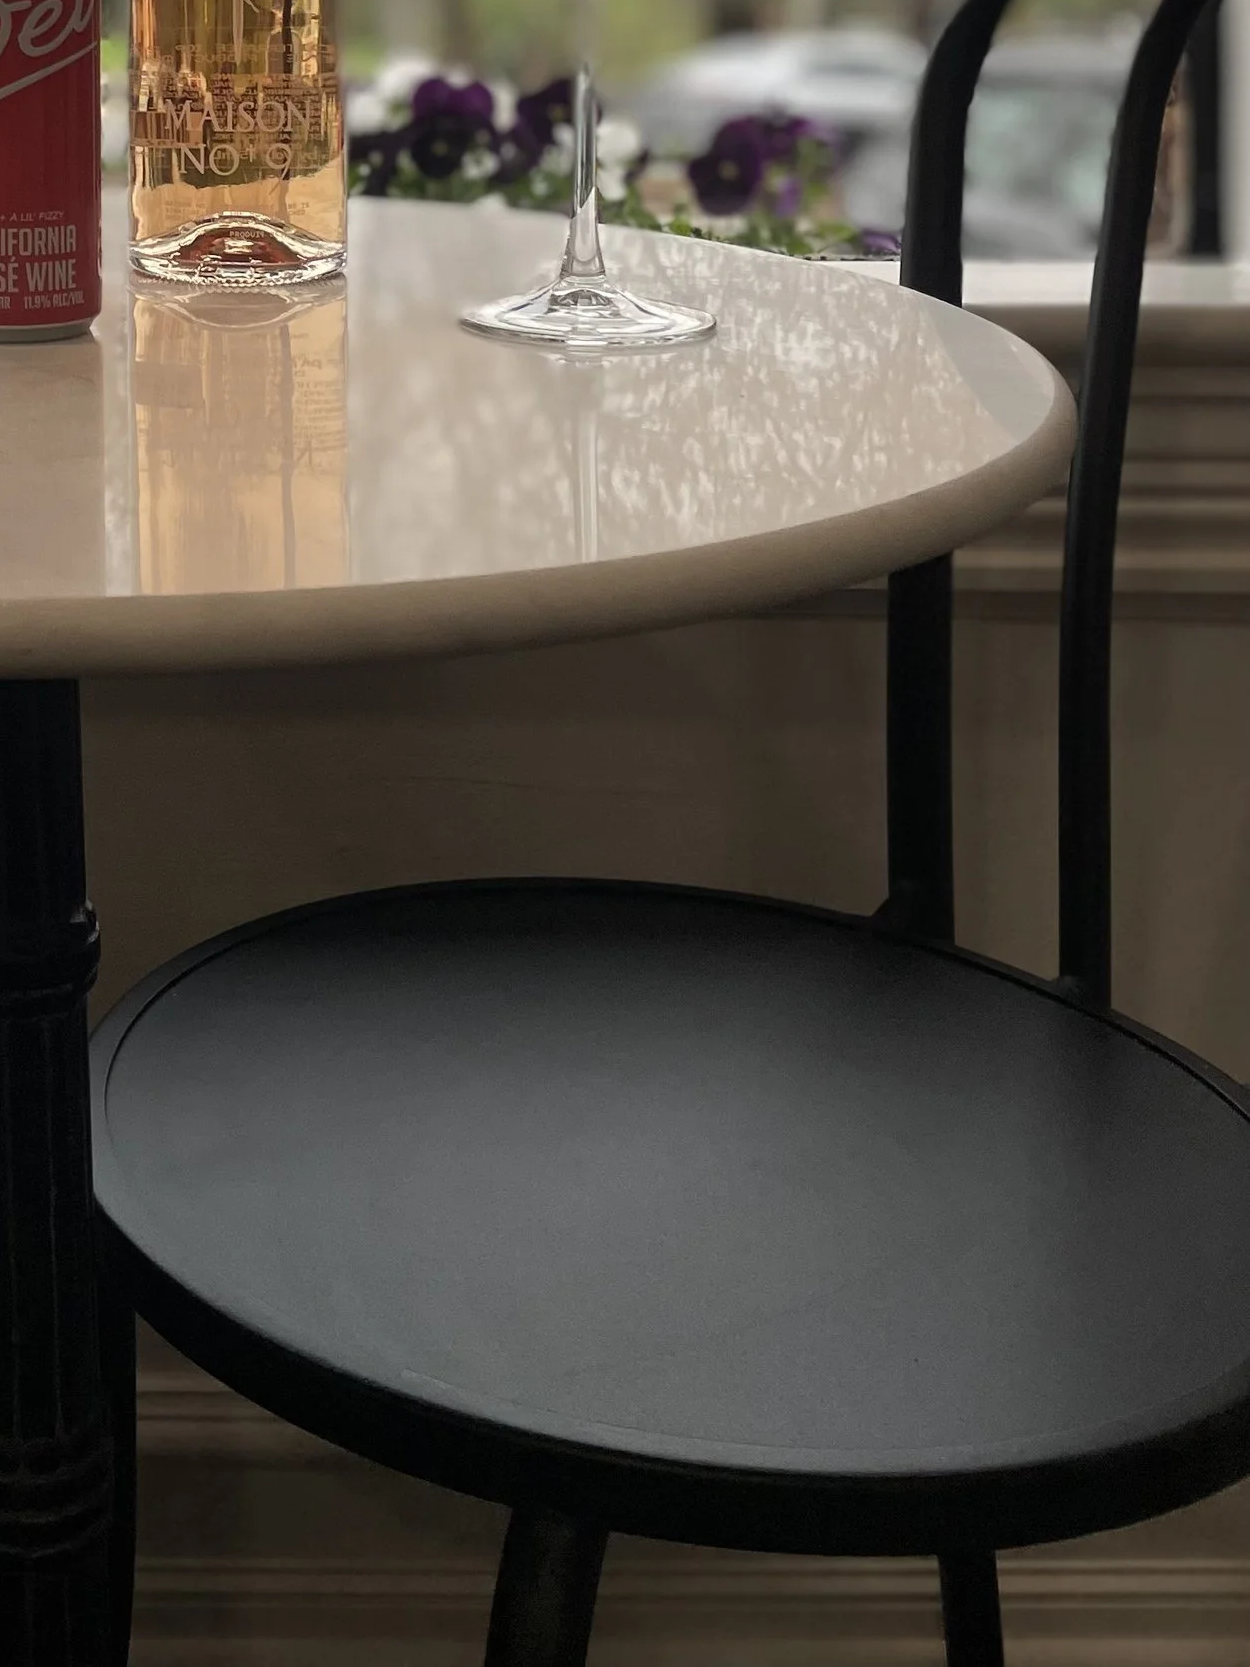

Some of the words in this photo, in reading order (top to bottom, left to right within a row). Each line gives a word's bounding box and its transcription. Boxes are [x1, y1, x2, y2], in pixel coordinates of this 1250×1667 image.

[165, 99, 311, 134] MAISON
[179, 143, 240, 176] NO
[266, 143, 292, 192] 9
[9, 212, 18, 221] A
[26, 259, 77, 293] WINE
[24, 294, 51, 310] 11.9%
